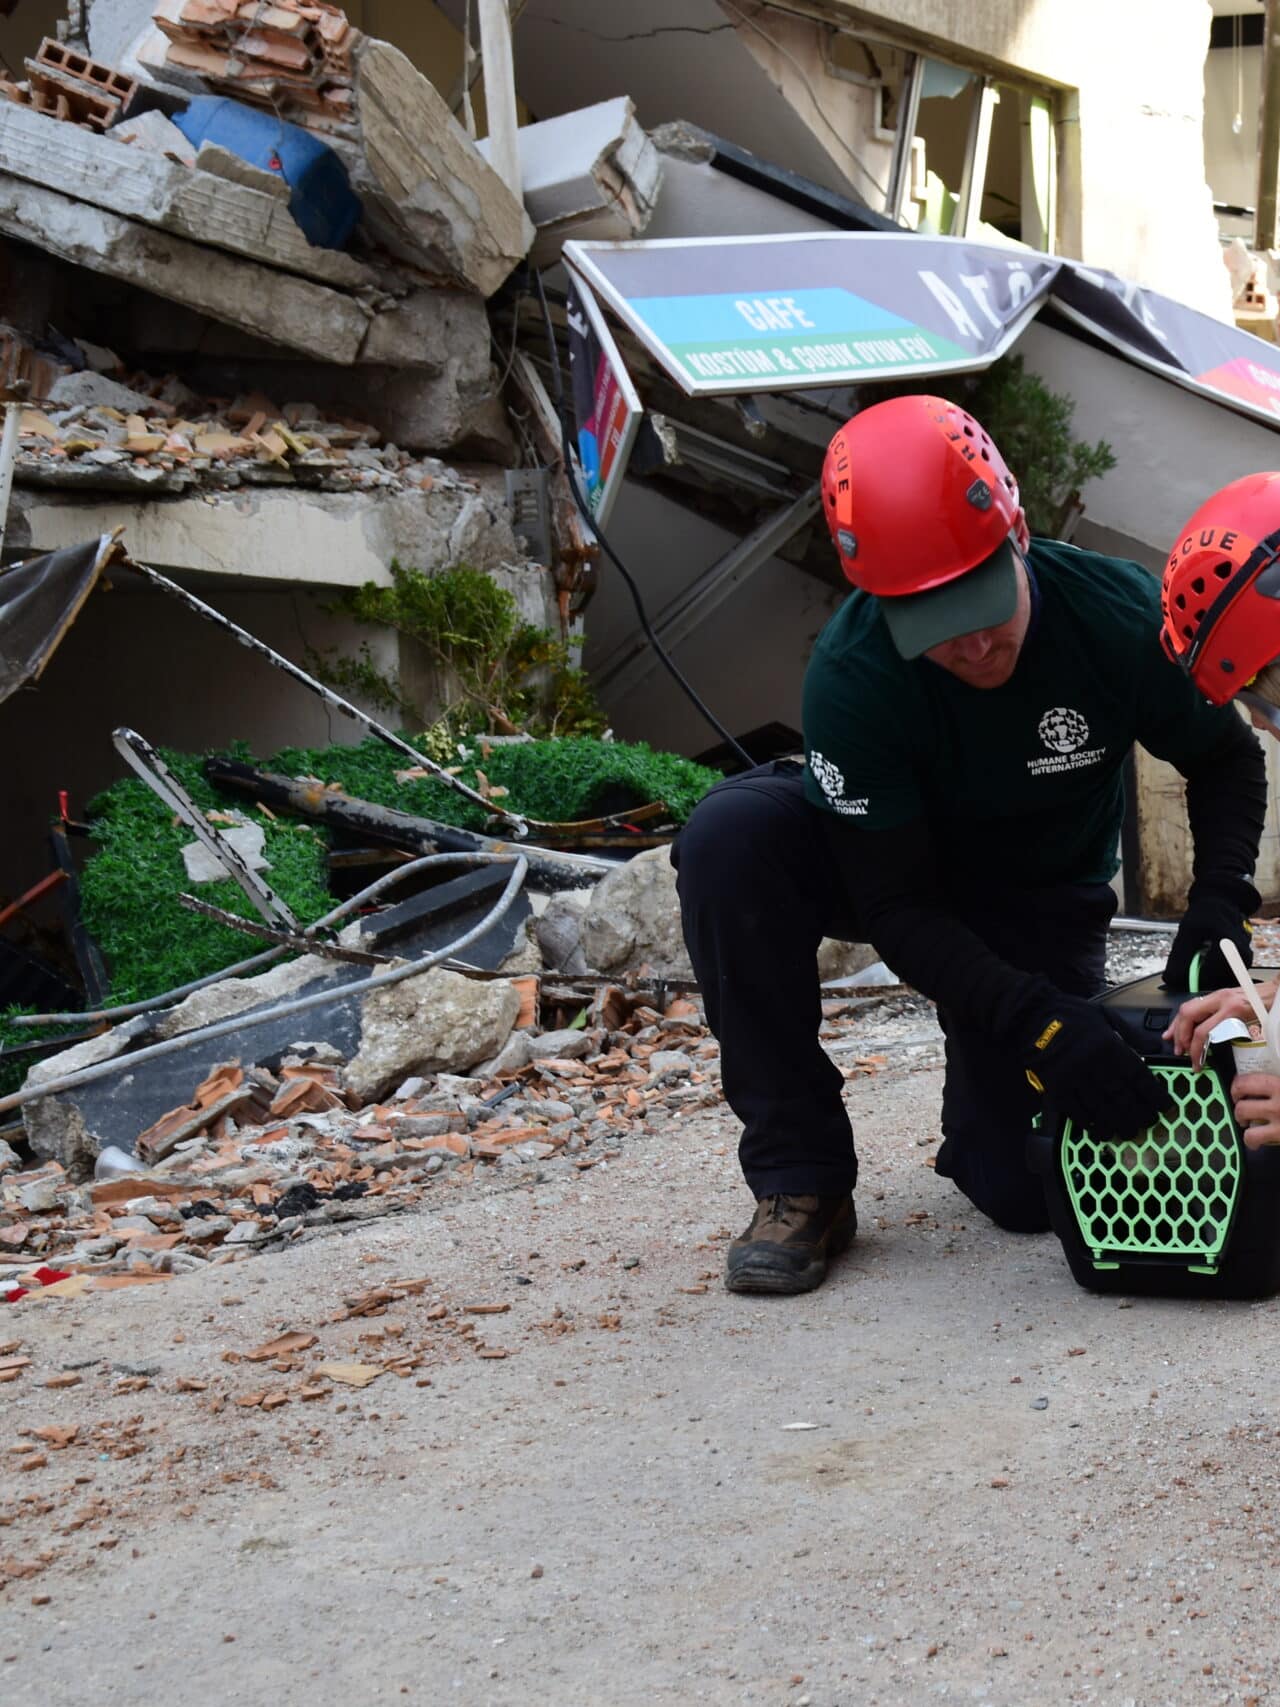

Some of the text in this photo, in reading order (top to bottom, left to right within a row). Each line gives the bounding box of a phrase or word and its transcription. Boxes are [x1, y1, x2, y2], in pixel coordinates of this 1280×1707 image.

[735, 298, 816, 331] CAFE
[686, 347, 778, 377] KOSTÜM
[772, 346, 800, 371] &
[792, 343, 863, 373] ÇOCUK
[852, 339, 906, 364] OYUN
[1027, 747, 1106, 768] HUMANE SOCIETY
[1031, 756, 1101, 776] INTERNATIONAL
